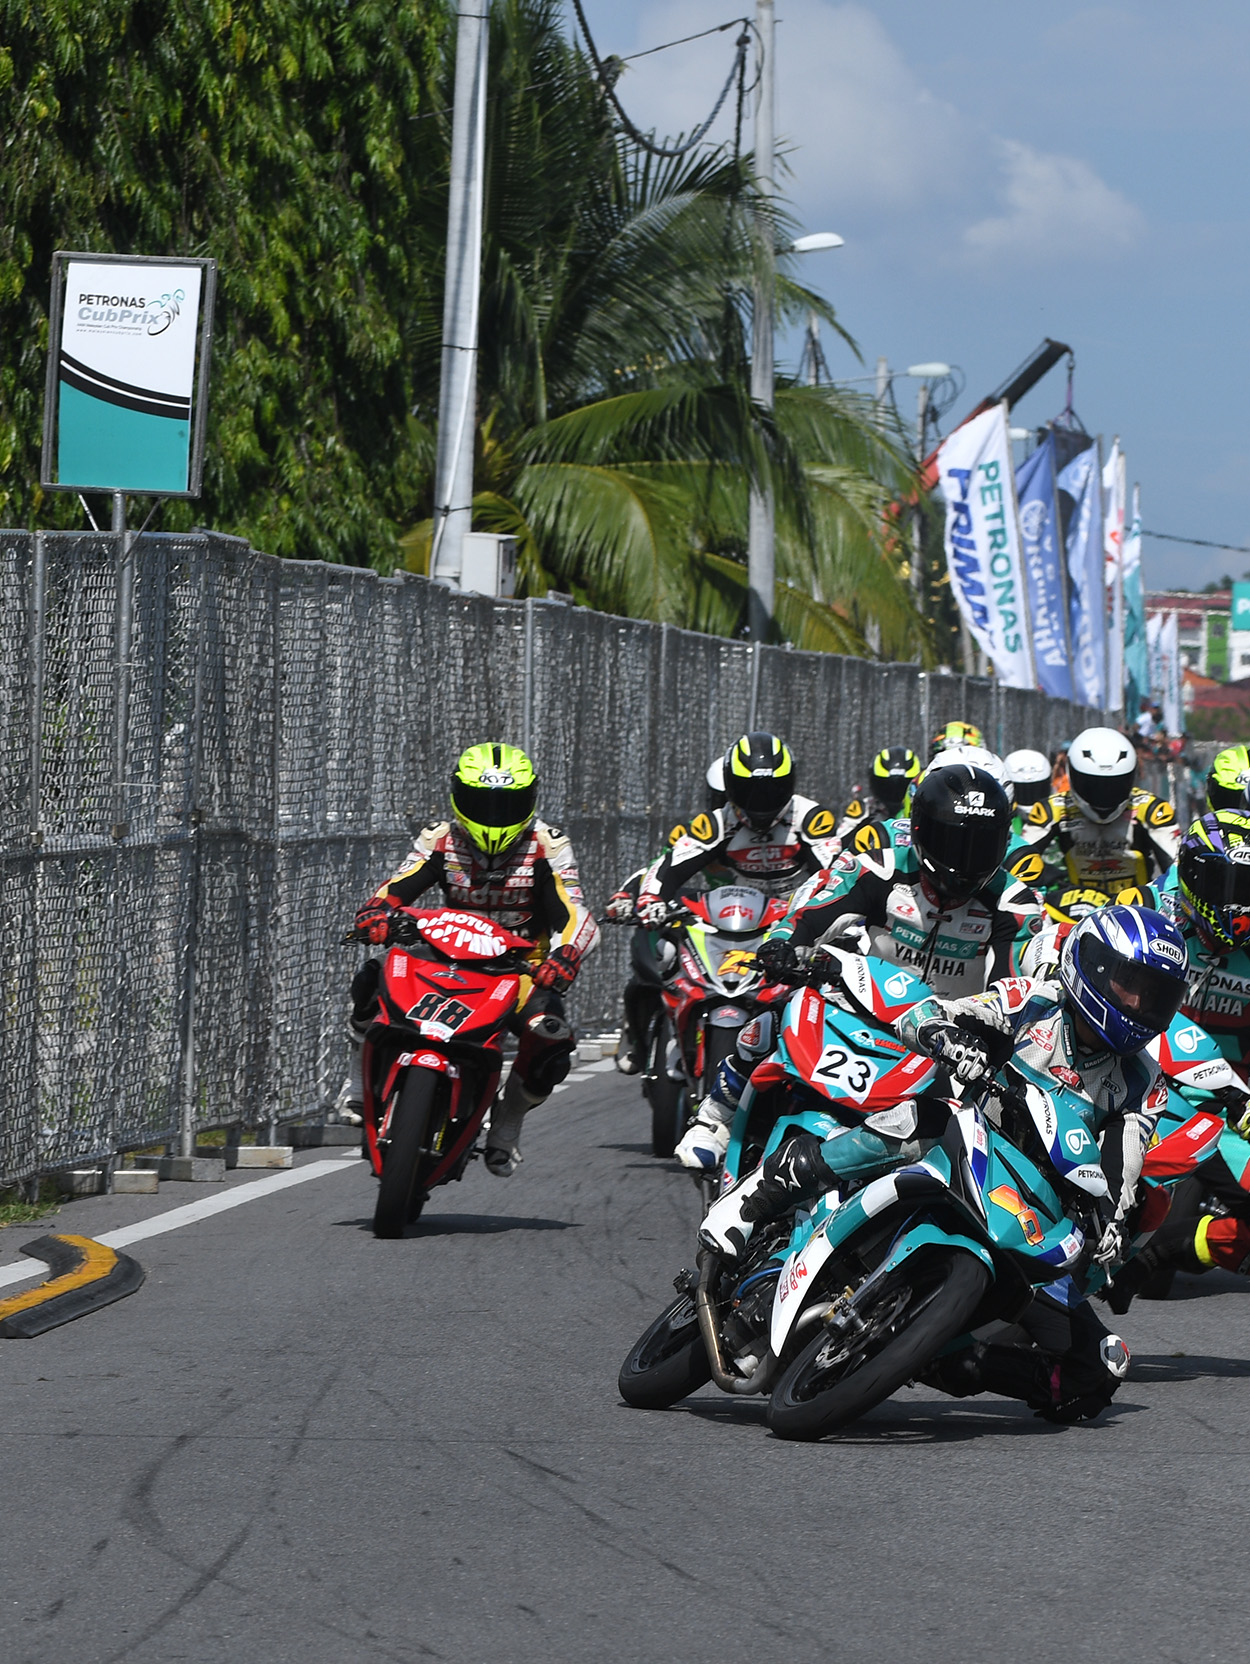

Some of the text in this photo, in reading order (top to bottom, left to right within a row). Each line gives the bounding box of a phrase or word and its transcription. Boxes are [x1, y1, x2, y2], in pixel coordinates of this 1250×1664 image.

[79, 293, 146, 309] PETRONAS
[78, 307, 159, 325] CubPrix
[978, 460, 1023, 654] PETRONAS
[482, 773, 513, 784] KYT
[954, 806, 996, 817] SHARK
[439, 912, 494, 937] MOTUL
[896, 926, 958, 952] PETRNAS
[1156, 944, 1183, 960] SHOEI
[406, 993, 475, 1031] 88
[1182, 993, 1243, 1017] AMAHA
[816, 1050, 871, 1093] 23
[1043, 1097, 1053, 1136] TRONAS
